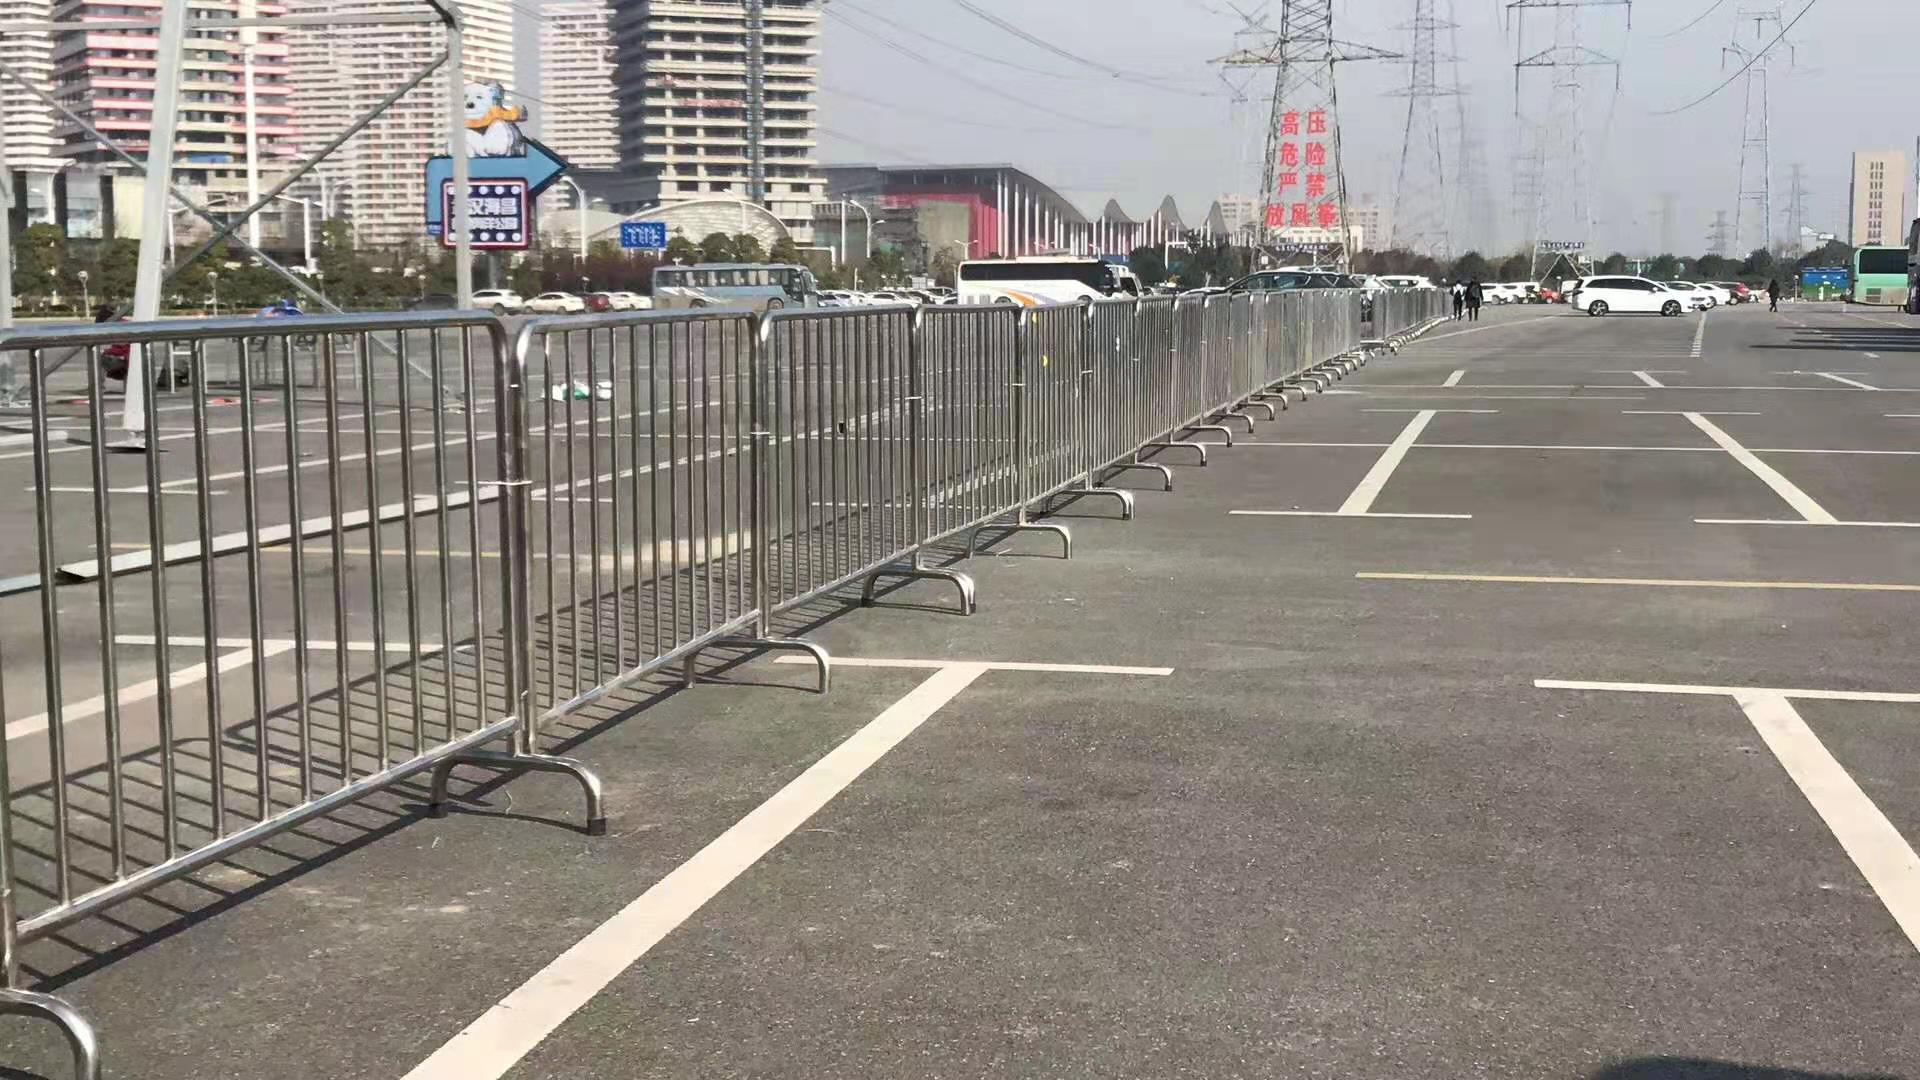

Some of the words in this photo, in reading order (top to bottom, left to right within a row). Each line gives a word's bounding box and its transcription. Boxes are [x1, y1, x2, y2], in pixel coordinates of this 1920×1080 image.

[1280, 107, 1327, 136] 高压
[1280, 142, 1326, 167] 危险
[1278, 172, 1326, 199] 严禁
[452, 198, 517, 215] 汉海昌
